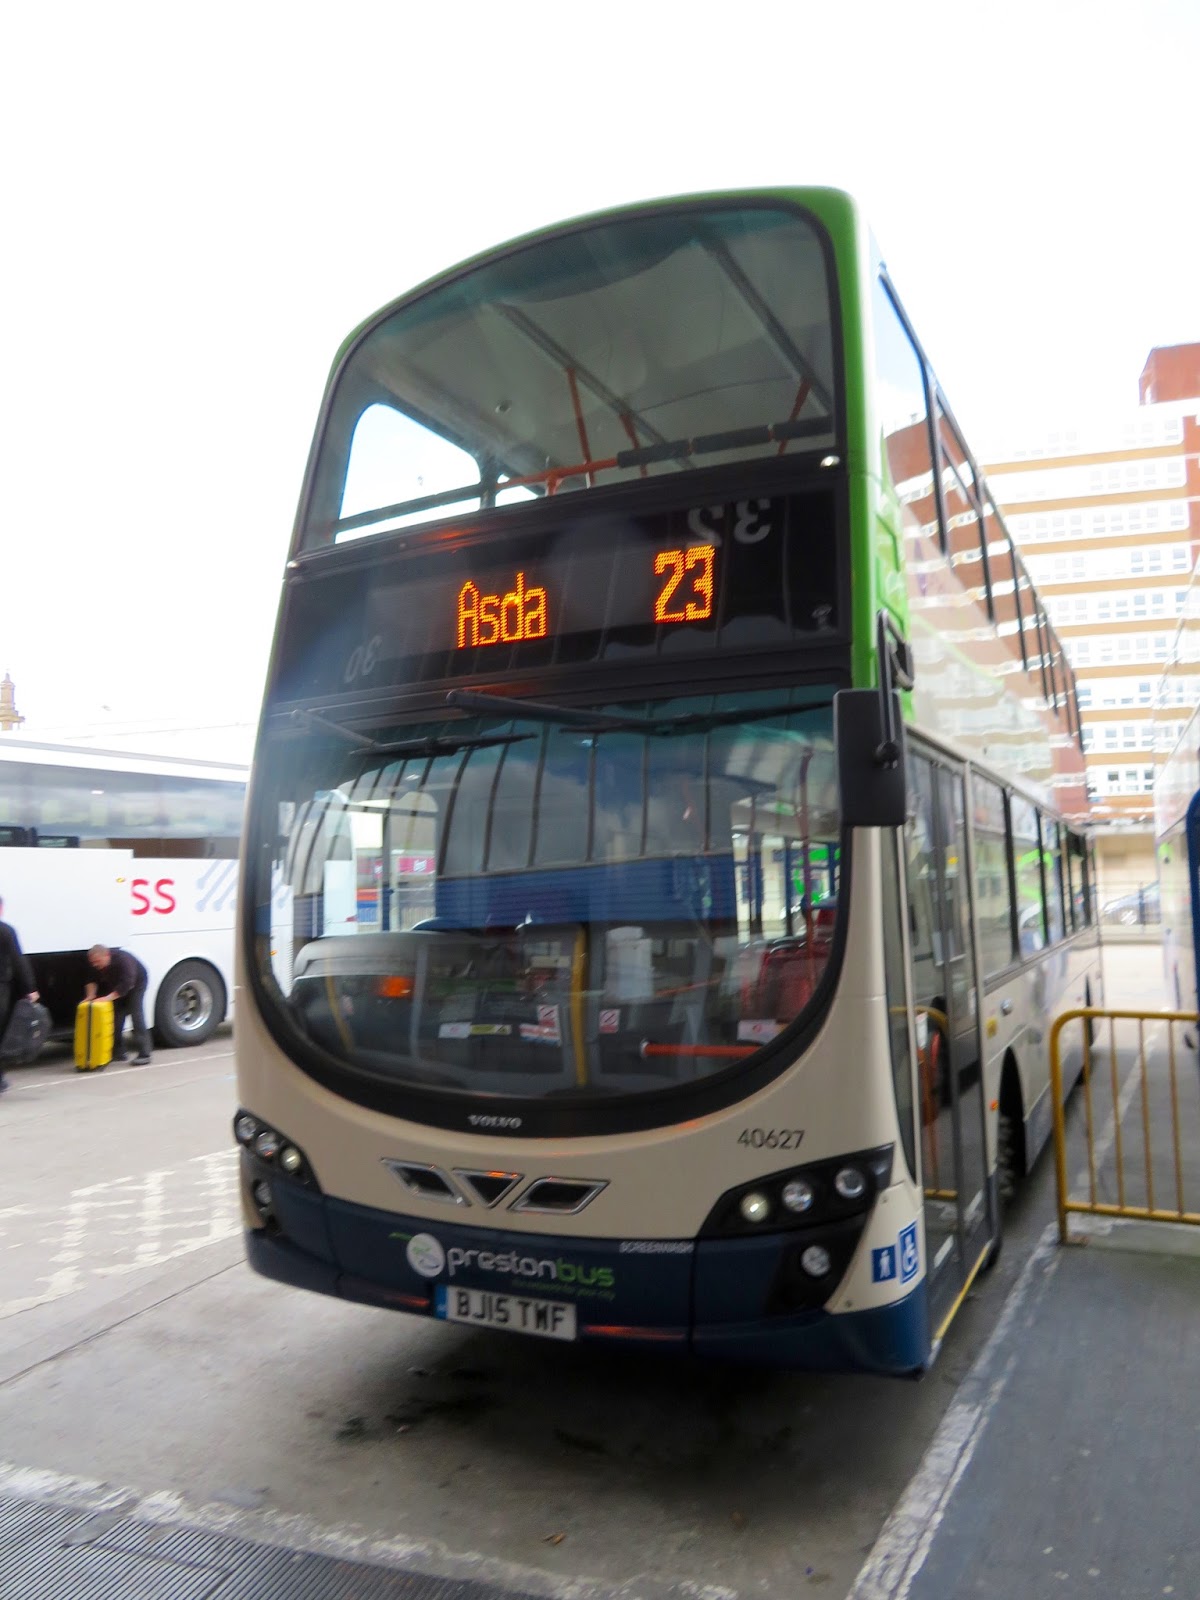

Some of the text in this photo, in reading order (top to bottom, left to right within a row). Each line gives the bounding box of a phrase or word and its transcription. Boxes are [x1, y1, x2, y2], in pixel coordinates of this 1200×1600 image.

[458, 545, 715, 648] Asda 23
[467, 1114, 523, 1129] VOLVO
[737, 1127, 805, 1150] 40627
[456, 1290, 510, 1324] BJ15
